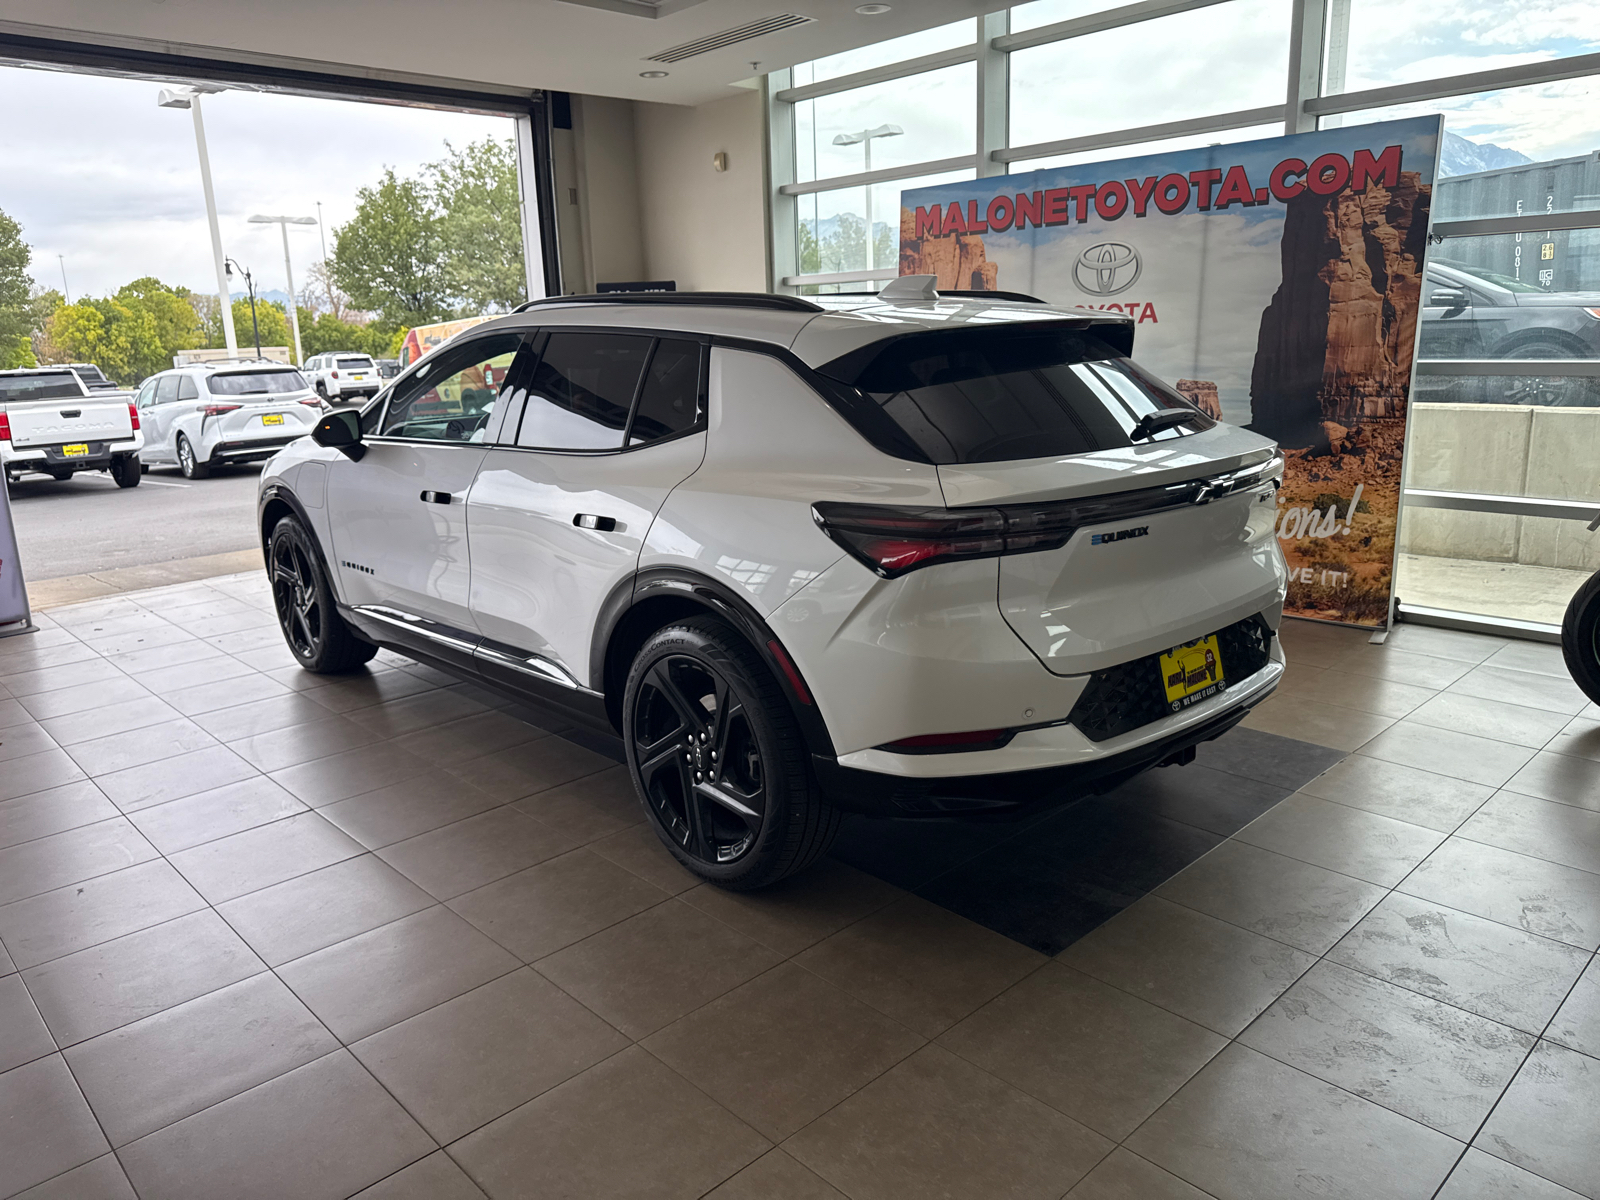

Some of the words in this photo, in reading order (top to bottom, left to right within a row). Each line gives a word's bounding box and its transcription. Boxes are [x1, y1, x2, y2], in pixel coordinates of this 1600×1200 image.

[914, 144, 1403, 239] MALONETOYOTA.COM
[32, 421, 115, 434] TACOMA
[1091, 526, 1149, 545] EQUINOX
[1321, 571, 1348, 588] IT!
[1206, 653, 1213, 662] 32
[1183, 698, 1190, 706] WE
[1190, 693, 1202, 702] MAKE
[1207, 686, 1216, 696] EASY
